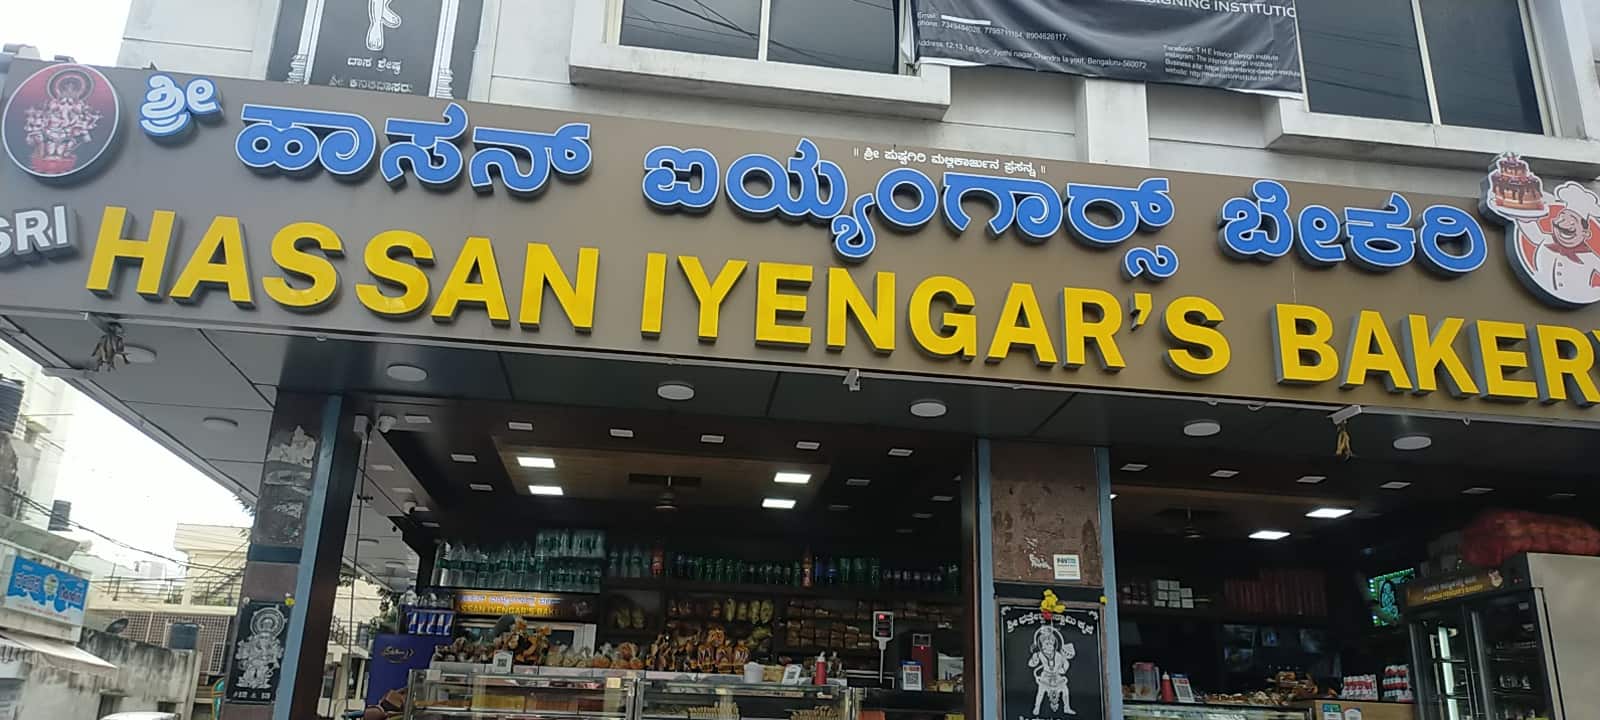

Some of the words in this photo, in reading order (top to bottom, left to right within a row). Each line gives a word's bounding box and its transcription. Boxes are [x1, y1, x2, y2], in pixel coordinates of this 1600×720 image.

[138, 73, 219, 137] ಶ್ರೀ
[234, 103, 593, 193] ಹಾಸನ್
[1220, 180, 1488, 272] ಬೇಕರಿ
[863, 147, 880, 161] ಶ್ರೀ
[1004, 161, 1037, 177] ಪ್ರಸನ್ನ
[87, 206, 599, 330] HASSAN
[1275, 303, 1600, 403] BAKER
